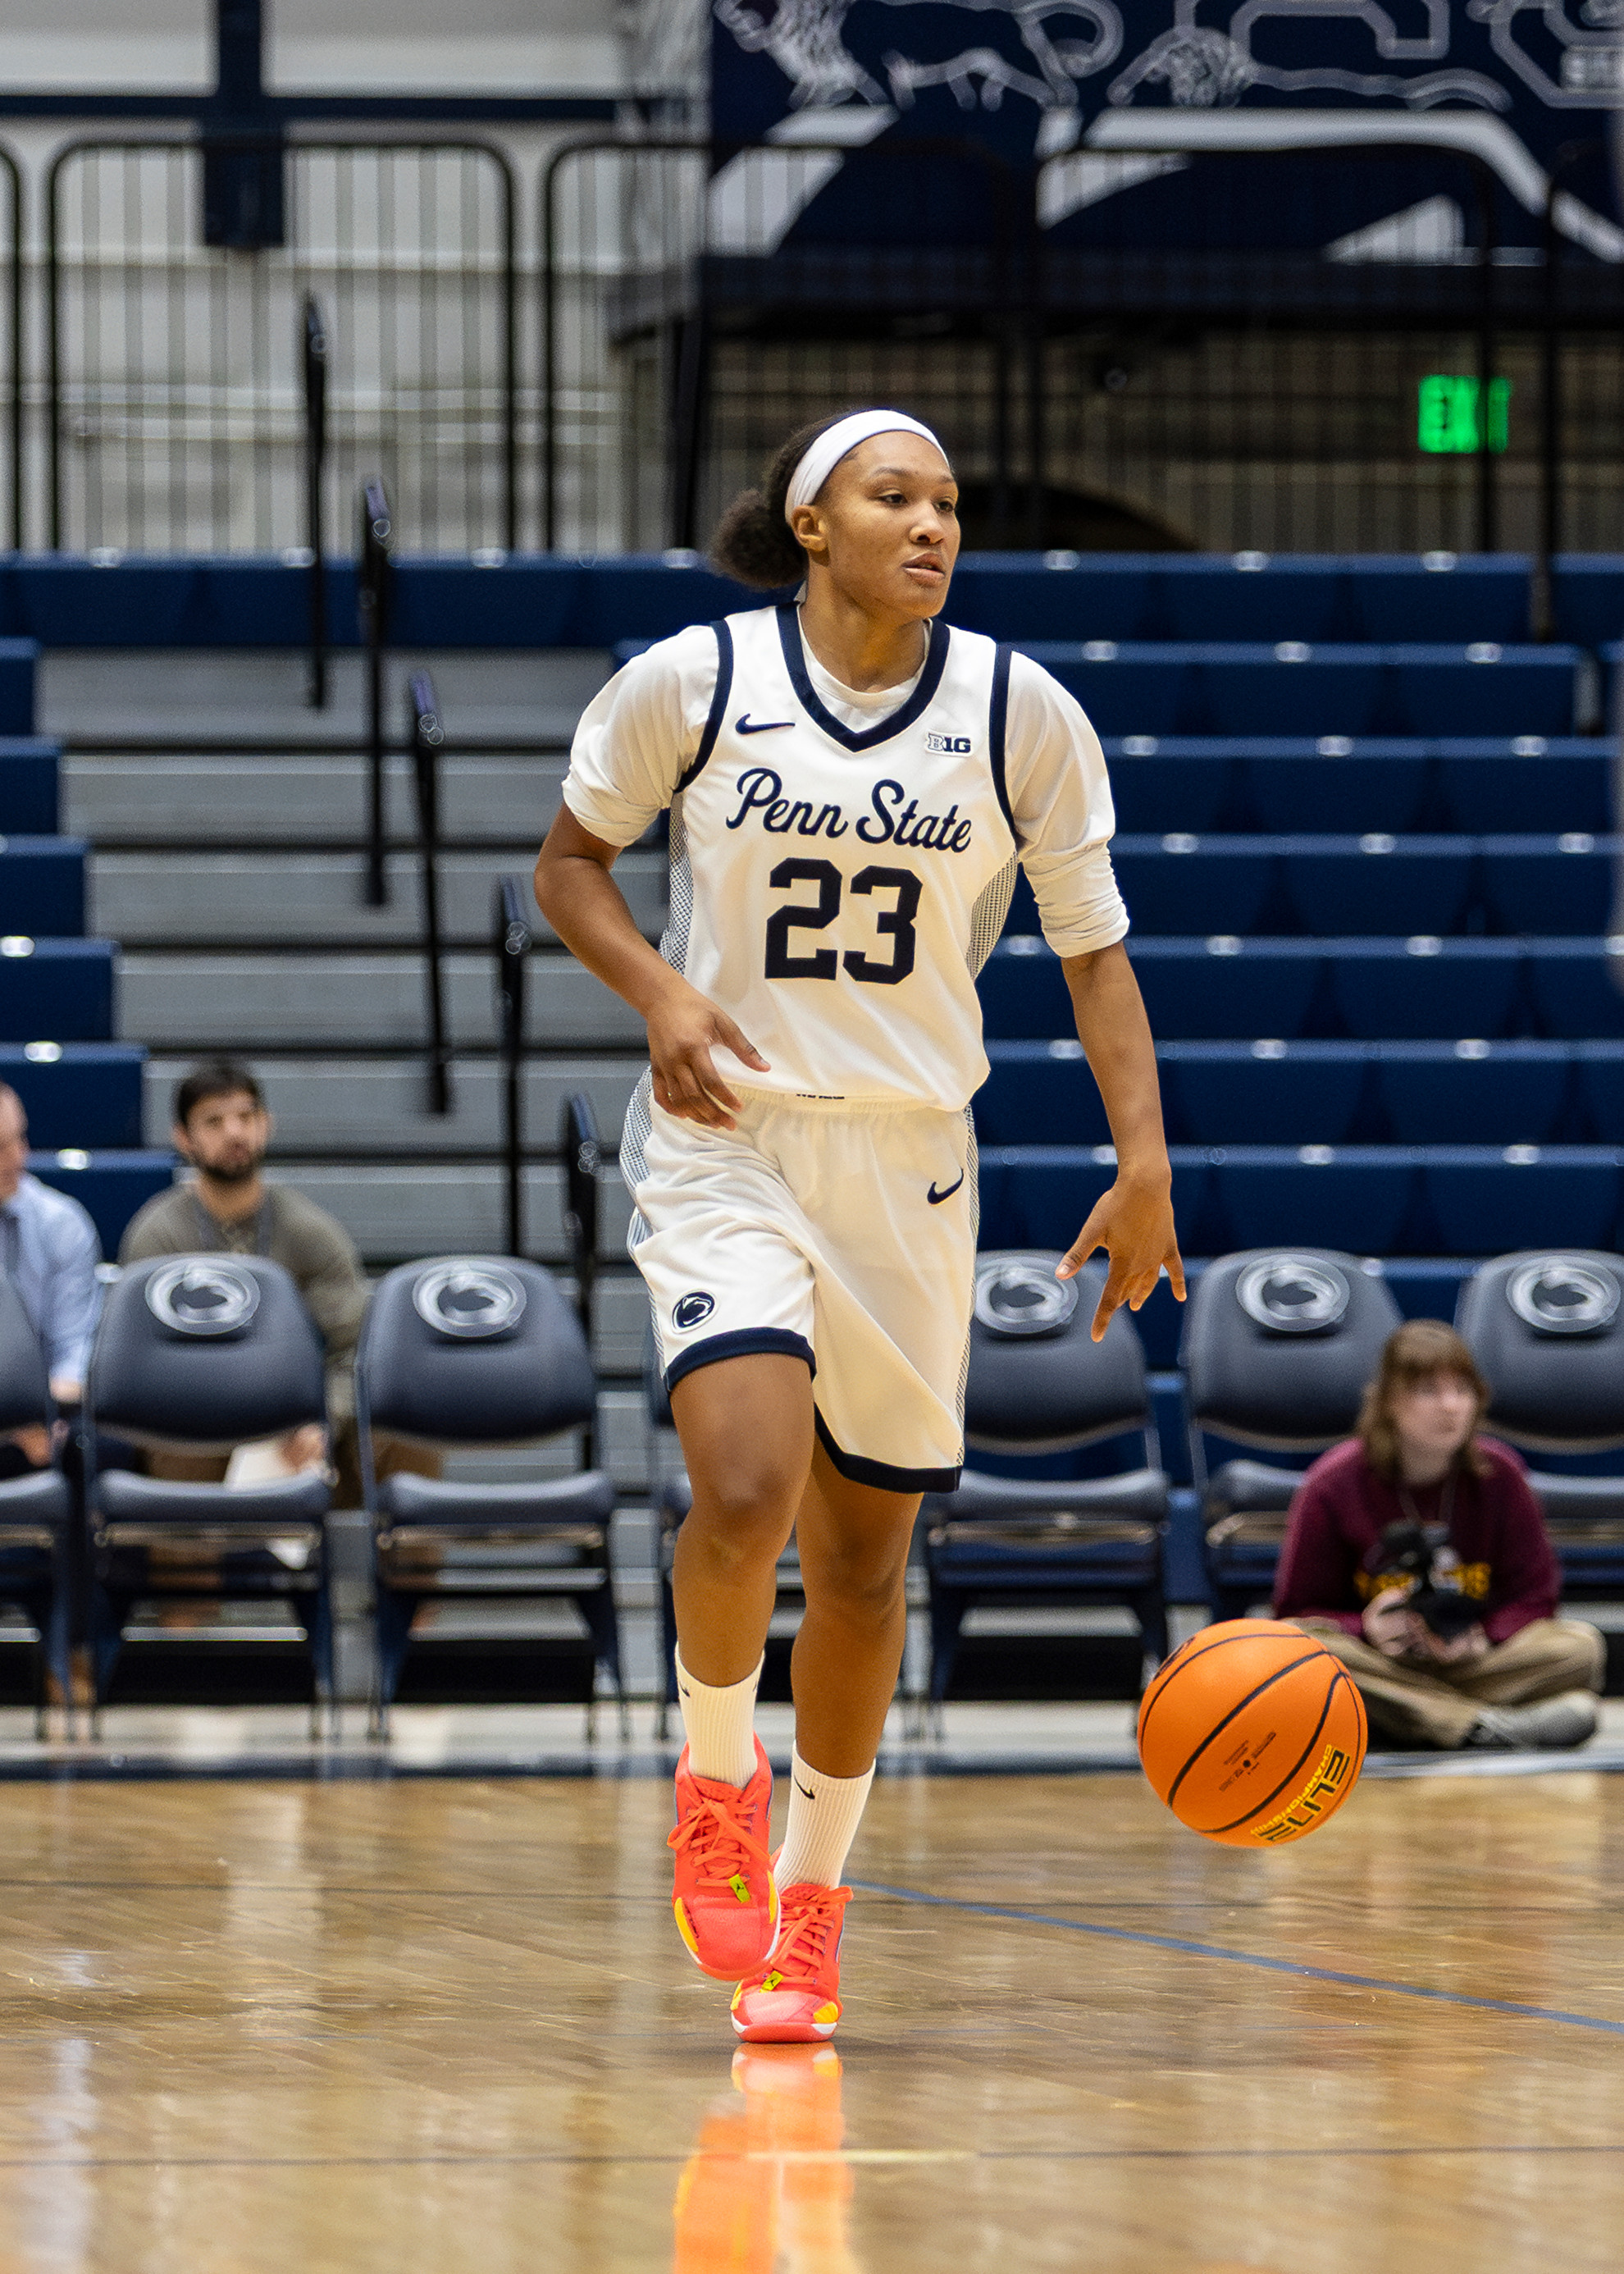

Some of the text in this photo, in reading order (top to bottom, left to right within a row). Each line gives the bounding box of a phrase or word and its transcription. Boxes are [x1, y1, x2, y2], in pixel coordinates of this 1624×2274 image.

[726, 767, 972, 853] Penn State
[764, 856, 923, 985] 23
[1257, 1748, 1351, 1842] ELITE
